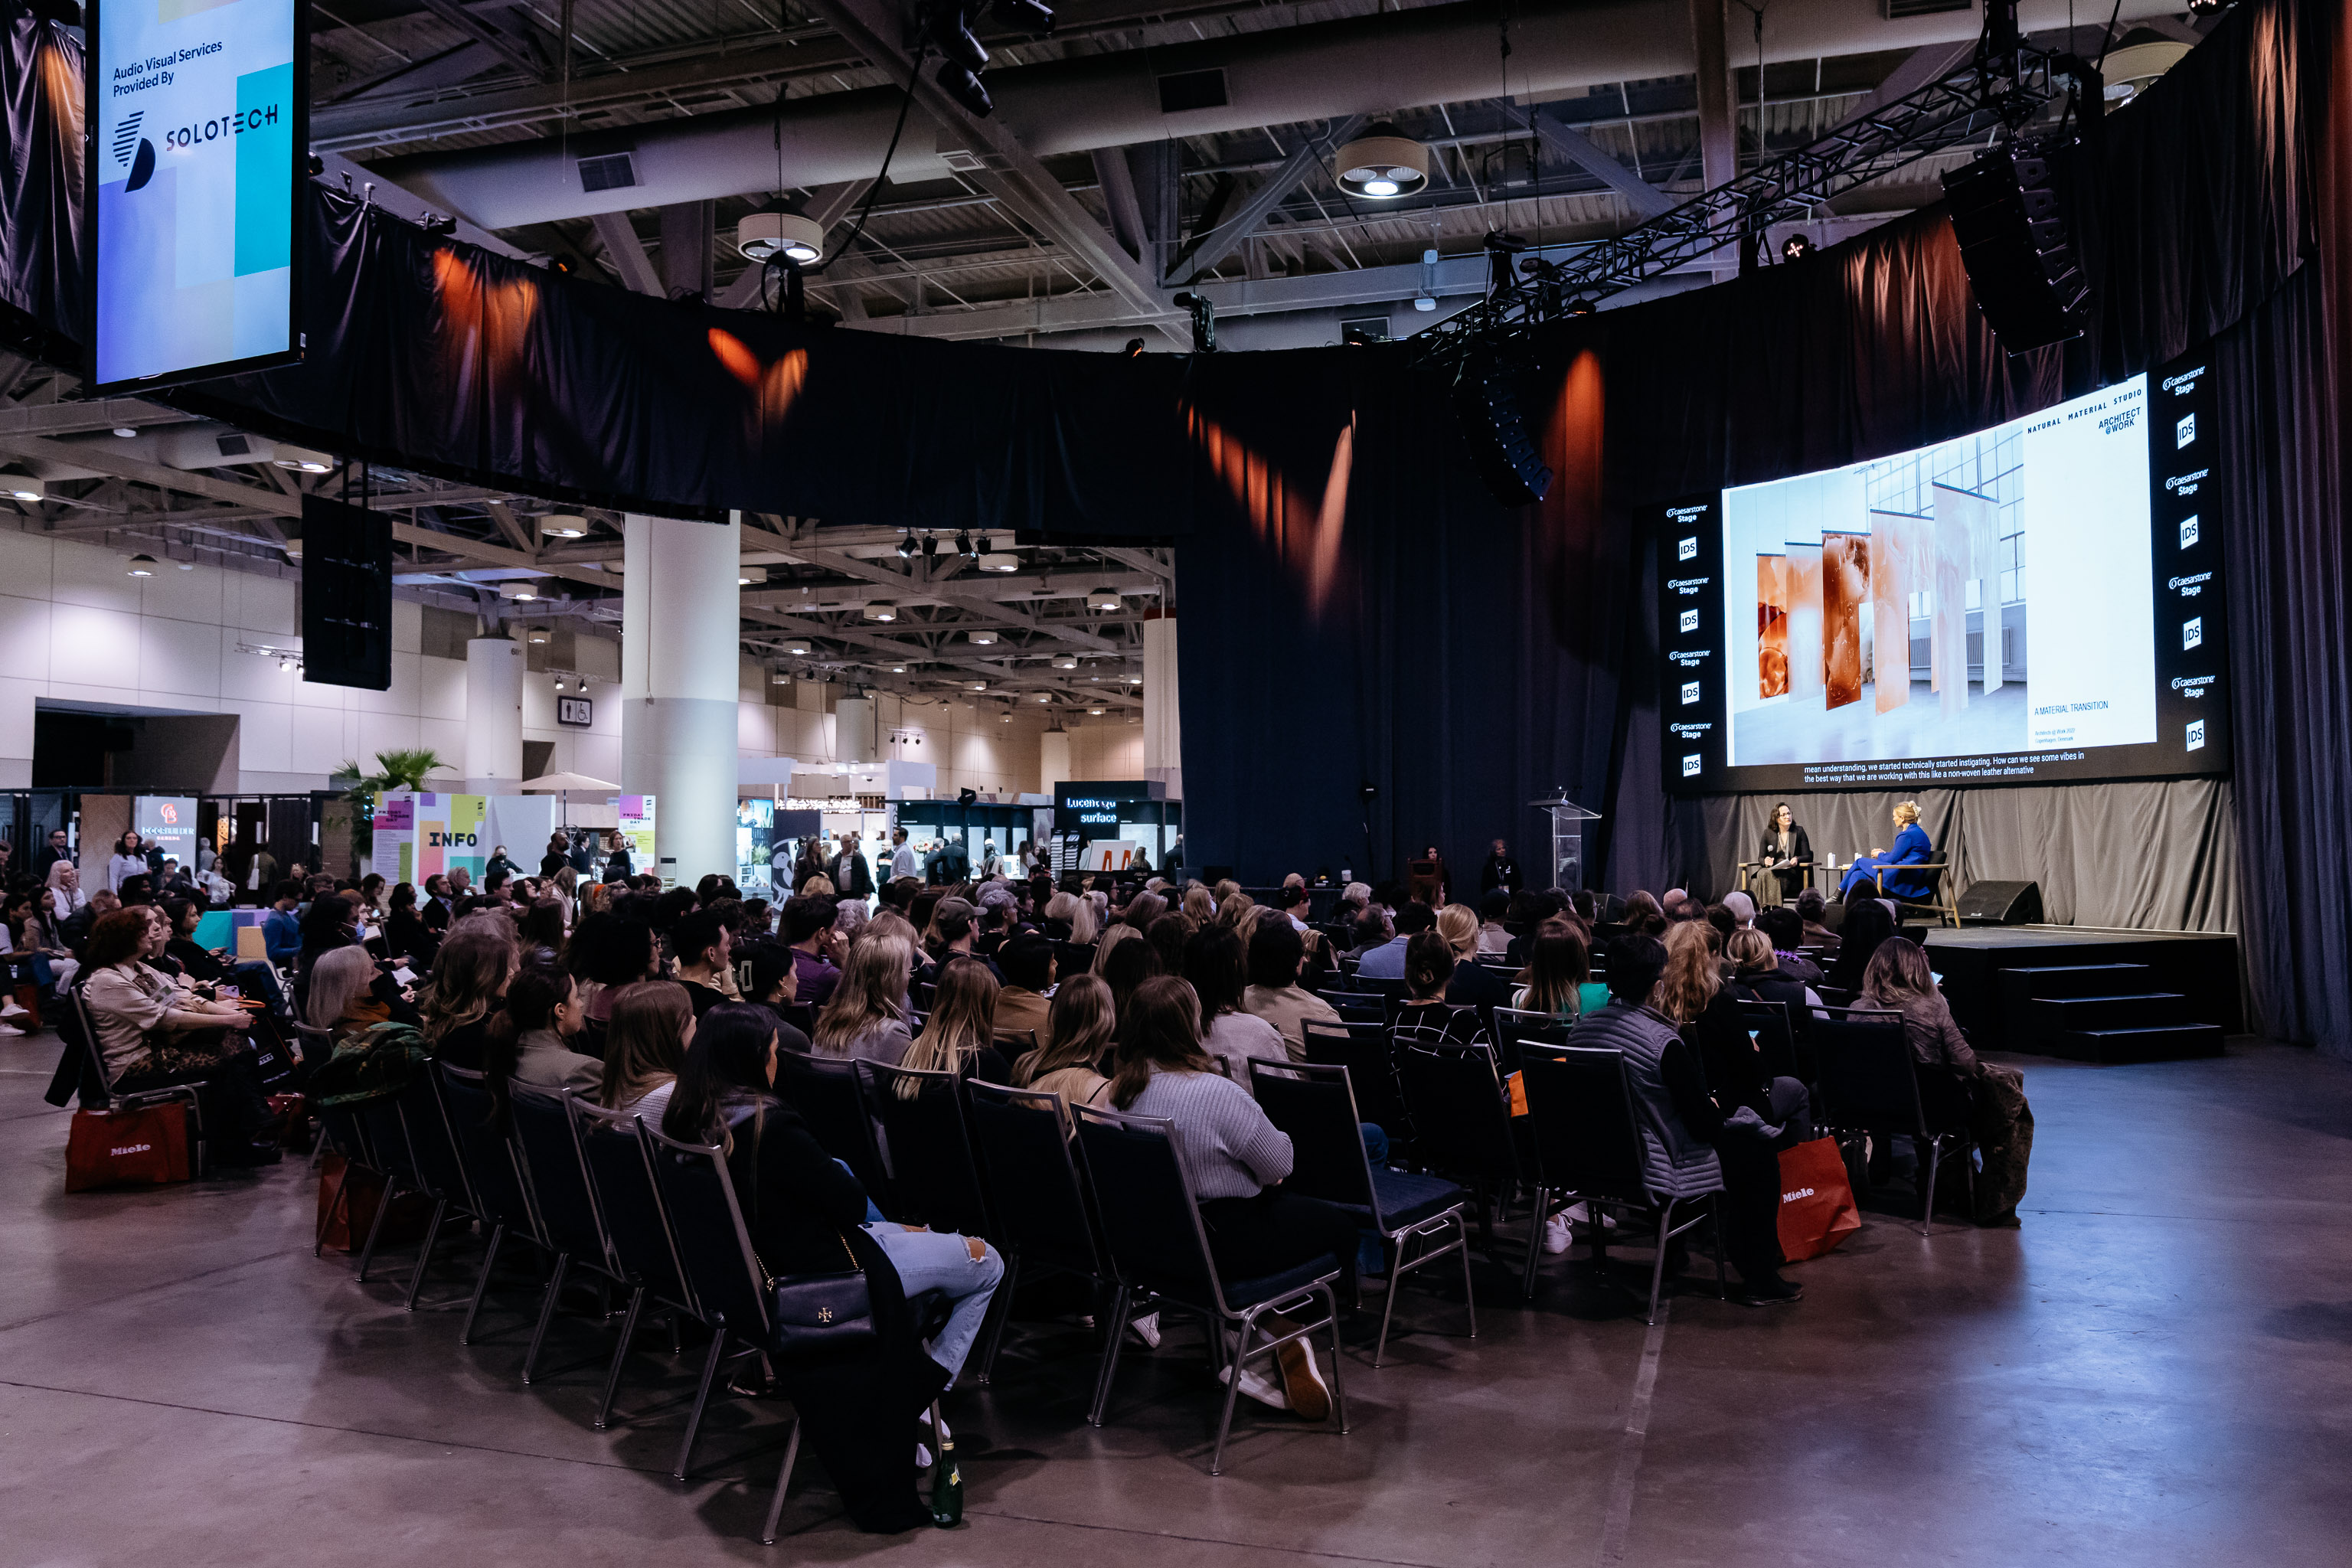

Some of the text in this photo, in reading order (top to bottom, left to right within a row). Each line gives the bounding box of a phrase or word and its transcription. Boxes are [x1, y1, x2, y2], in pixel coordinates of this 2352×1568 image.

[113, 41, 223, 80] Audio Visual Services
[113, 71, 175, 97] Provided By
[166, 104, 278, 152] SOLOTECH
[2175, 382, 2194, 396] Stage
[2027, 389, 2141, 434] NATURAL MATERIAL STUDIO
[2099, 407, 2141, 429] ARCHITECT
[2105, 418, 2135, 435] @WORK
[2179, 422, 2194, 441] IDS
[2178, 483, 2198, 496] Stage
[1677, 514, 1697, 523] Stage
[2182, 524, 2197, 541] IDS
[1681, 543, 1695, 555] IDS
[1679, 586, 1698, 595] Stage
[2181, 586, 2201, 596] Stage
[1682, 615, 1697, 627] IDS
[2185, 626, 2200, 642] IDS
[1684, 688, 1698, 698] IDS
[2184, 688, 2204, 698] Stage
[2040, 705, 2069, 715] MATERIAL
[2070, 701, 2109, 712] TRANSITION
[1681, 731, 1701, 740] Stage
[2188, 728, 2203, 743] IDS
[1684, 760, 1700, 771] IDS
[1822, 763, 1867, 773] understanding,
[1879, 762, 1901, 771] started
[1902, 760, 1935, 770] technically
[1936, 758, 1957, 768] started
[1958, 757, 1992, 768] instigating.
[1993, 756, 2007, 765] How
[2041, 753, 2059, 762] some
[2060, 752, 2077, 760] vibes
[2078, 751, 2085, 760] in
[1830, 775, 1842, 783] way
[1843, 773, 1855, 782] that
[1878, 772, 1903, 782] working
[1904, 771, 1918, 779] with
[1919, 770, 1930, 779] this
[1931, 770, 1942, 779] like
[1948, 769, 1981, 778] non-woven
[1981, 766, 2002, 776] leather
[2003, 766, 2034, 776] alternative
[1080, 812, 1117, 823] surface
[429, 832, 478, 847] INFO
[110, 1144, 151, 1156] Miele
[1782, 1188, 1815, 1204] Miele
